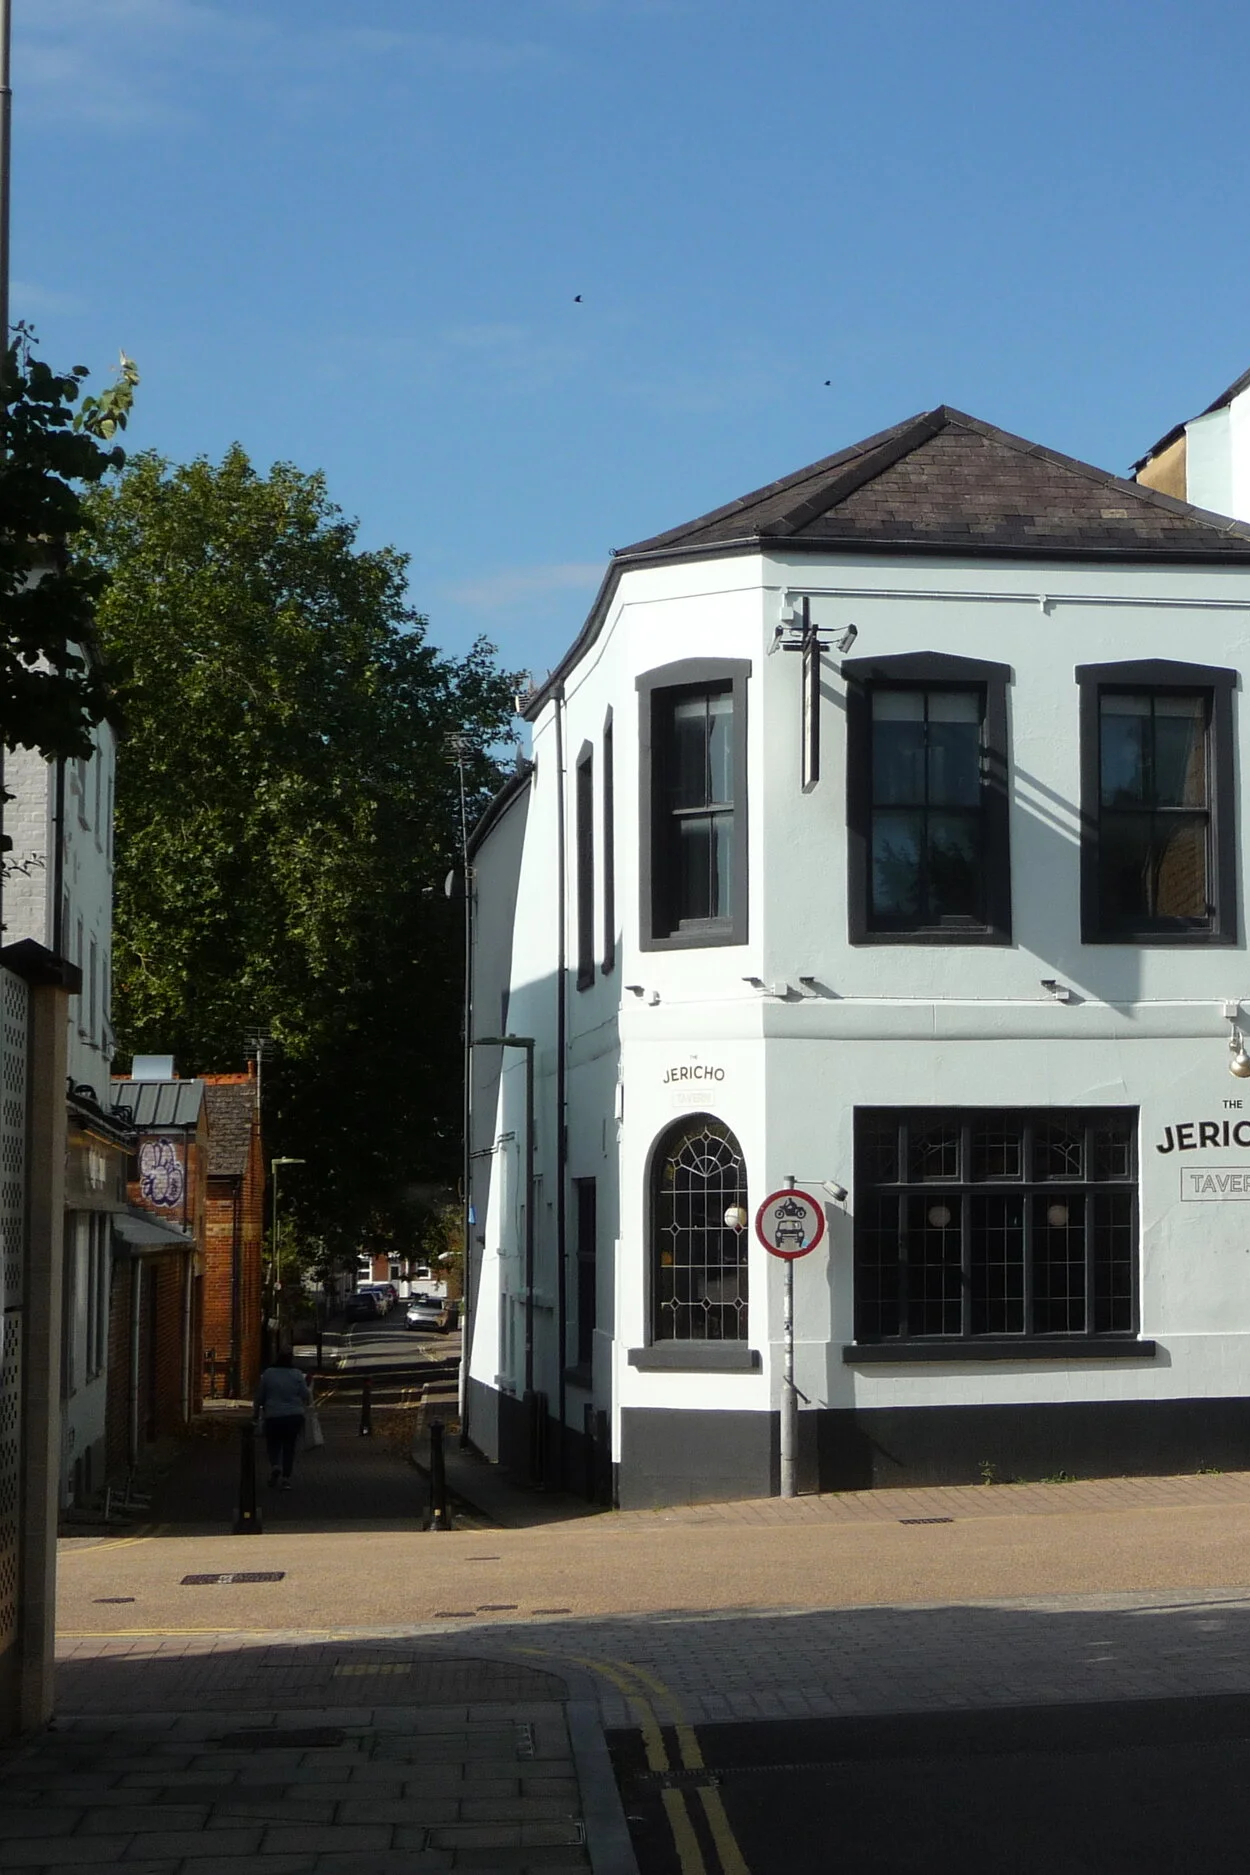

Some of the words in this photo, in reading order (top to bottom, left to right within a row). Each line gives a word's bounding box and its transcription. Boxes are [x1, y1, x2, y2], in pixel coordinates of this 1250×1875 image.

[663, 1065, 725, 1083] JERICHO
[676, 1092, 712, 1104] TAVERN
[1222, 1099, 1243, 1109] THE
